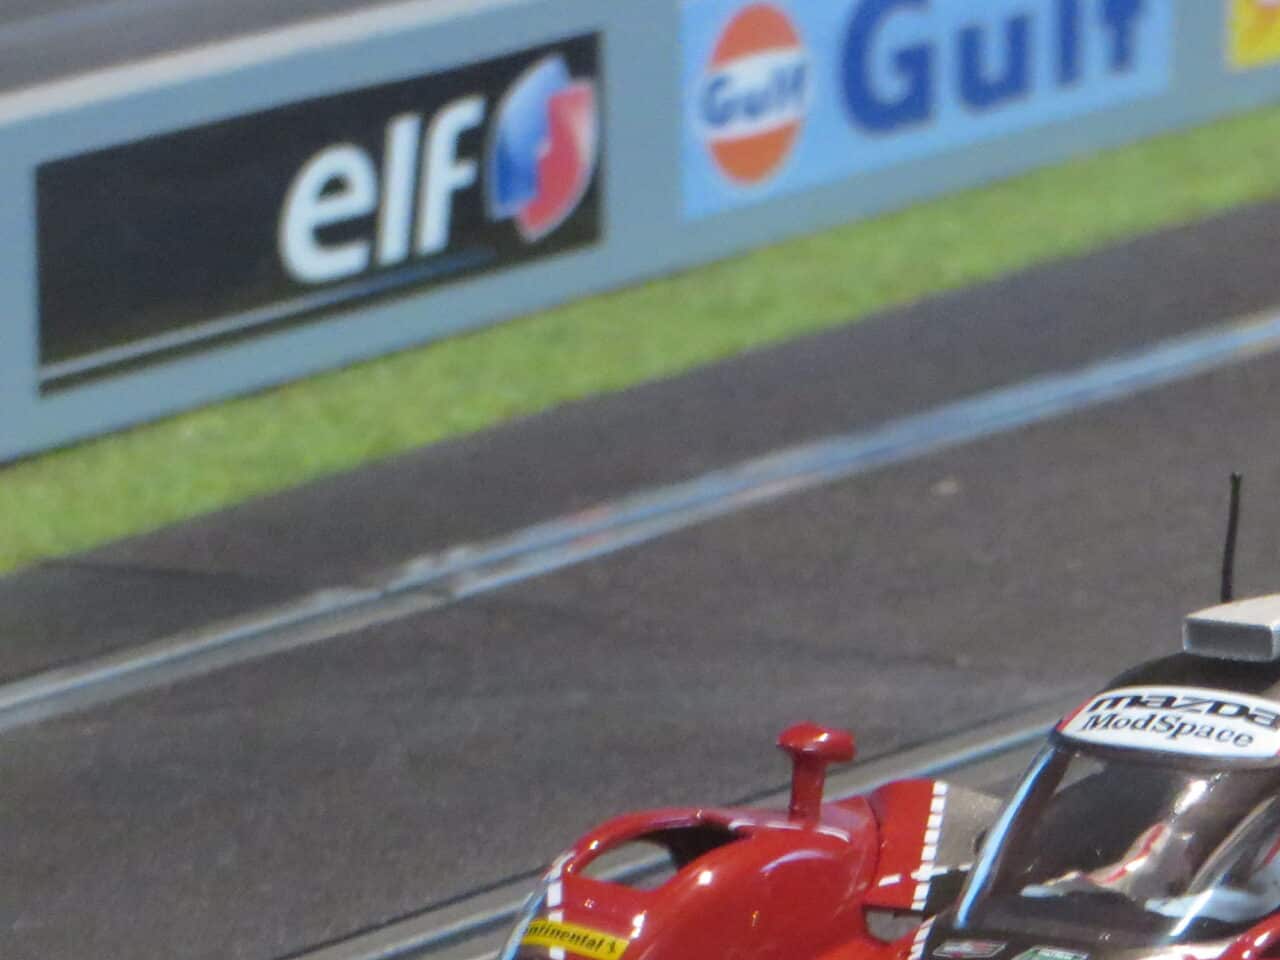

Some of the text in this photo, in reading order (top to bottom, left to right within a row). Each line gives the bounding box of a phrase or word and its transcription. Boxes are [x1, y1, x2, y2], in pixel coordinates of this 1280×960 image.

[279, 97, 486, 284] elf
[1082, 713, 1255, 747] ModSpace
[520, 923, 604, 953] ntinental
